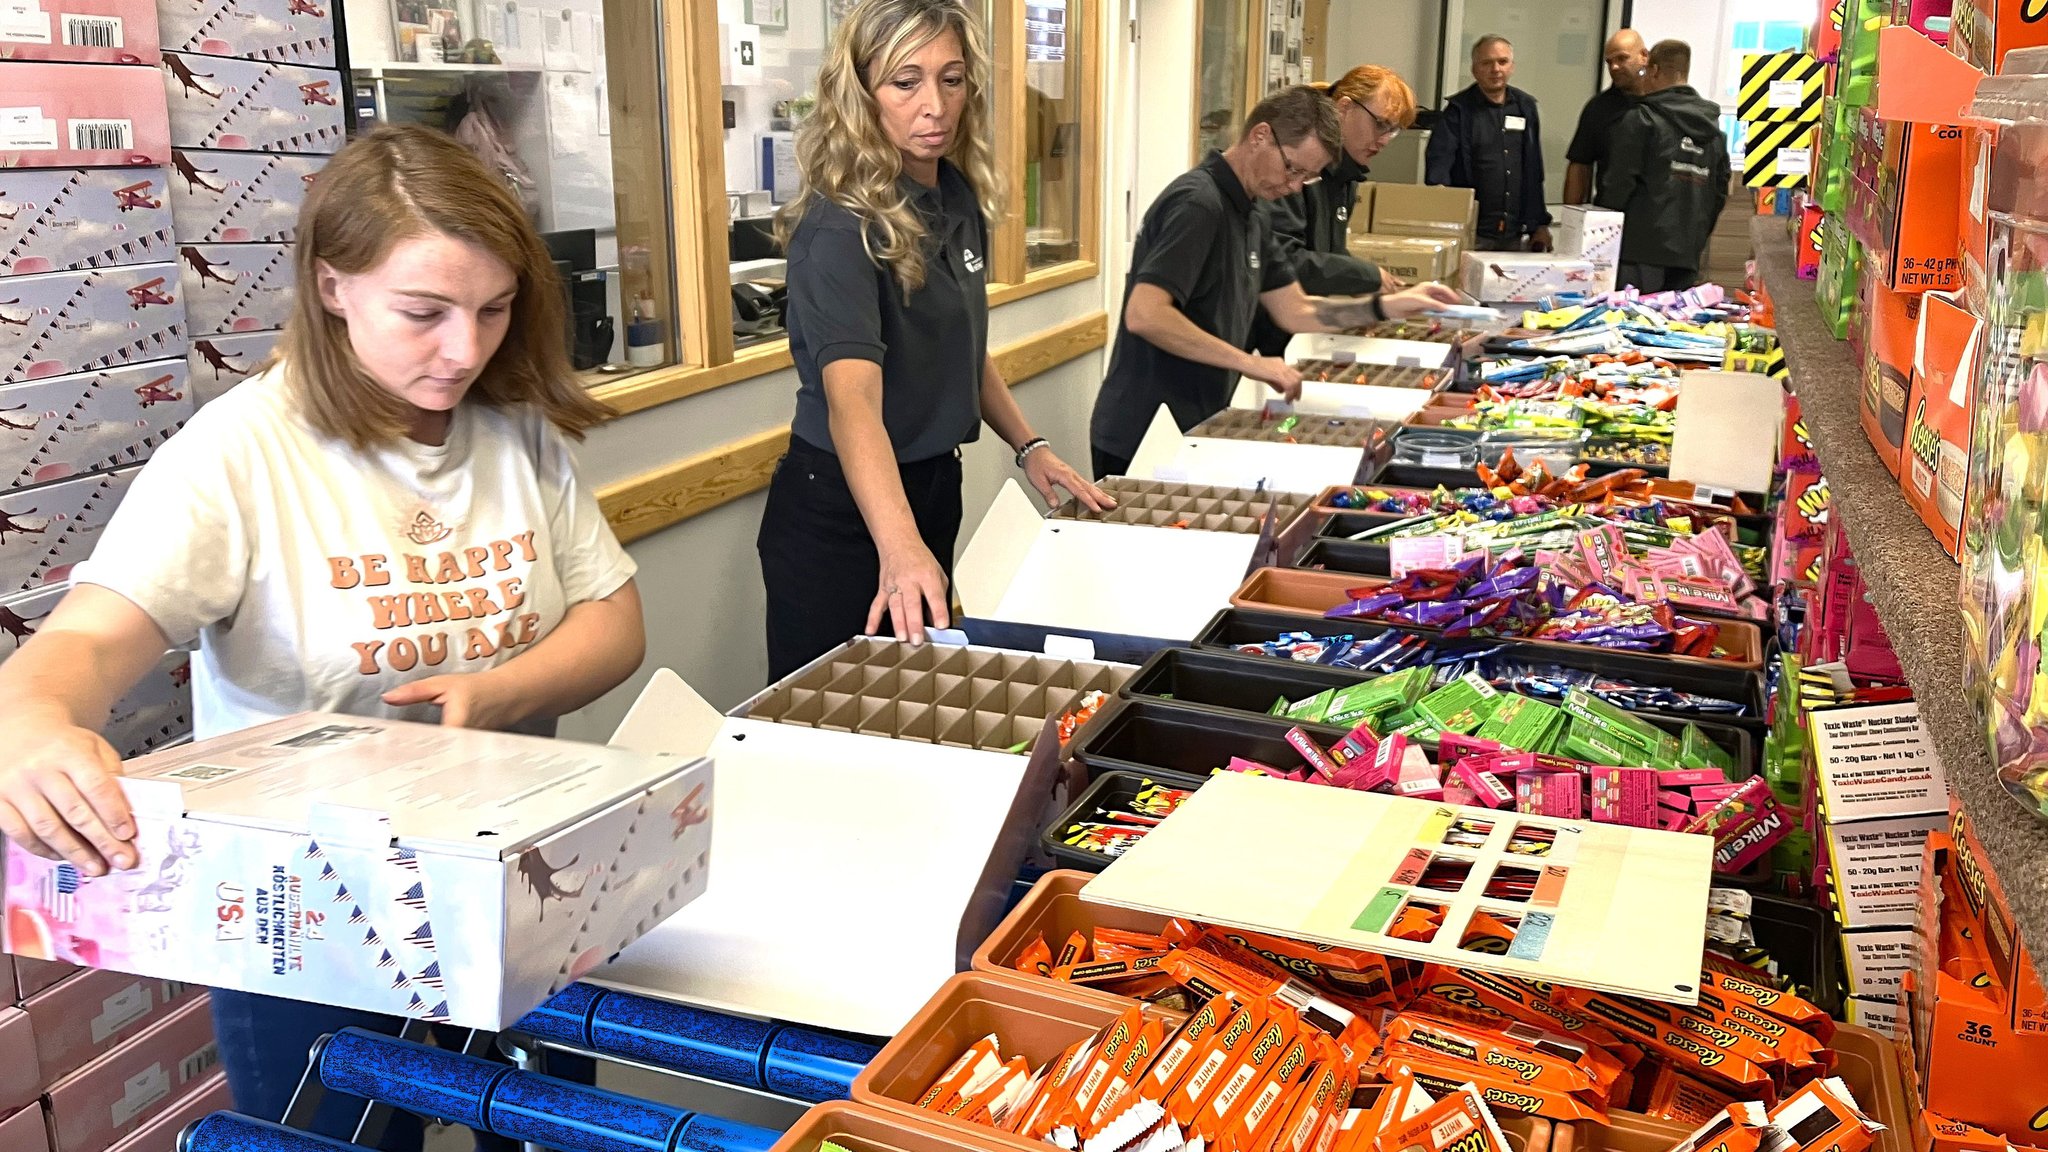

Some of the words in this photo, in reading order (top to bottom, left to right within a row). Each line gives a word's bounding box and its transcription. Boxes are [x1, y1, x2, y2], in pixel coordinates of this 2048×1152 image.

[1902, 273, 1918, 285] NET
[1921, 273, 1935, 284] WT
[1903, 258, 1915, 269] 36
[1924, 258, 1935, 269] 42
[1937, 260, 1944, 272] g
[1910, 396, 1942, 476] Reese's
[327, 554, 391, 589] BE
[402, 530, 538, 584] HAPPY
[367, 577, 526, 629] WHERE
[351, 632, 449, 675] YOU
[1328, 712, 1349, 723] Mike
[1568, 703, 1592, 721] Mike
[1593, 715, 1608, 729] Ike
[1824, 722, 1841, 731] Toxic
[1868, 717, 1893, 726] Nuclear
[1291, 731, 1312, 752] Mike
[1312, 751, 1324, 769] Ike
[1845, 755, 1860, 764] 20g
[1861, 753, 1877, 762] Bars
[1883, 752, 1896, 760] Net
[1904, 751, 1914, 760] kg
[1831, 773, 1932, 787] ToxicWasteCandy.co.uk
[1732, 812, 1782, 853] Mike
[1841, 834, 1858, 843] Toxic
[1885, 831, 1909, 840] Nuclear
[1863, 867, 1877, 876] 20g
[1878, 866, 1895, 874] Bars
[1900, 865, 1914, 873] Net
[1952, 808, 1987, 908] Reese's
[256, 887, 269, 914] AUS
[255, 917, 269, 945] DEN
[1856, 944, 1874, 952] Toxic
[1721, 977, 1780, 1007] Reese's
[1878, 978, 1892, 986] 20g
[1187, 1005, 1216, 1040] Reese's
[1529, 999, 1584, 1032] Reese's
[1864, 1012, 1881, 1020] Toxic
[2022, 1008, 2033, 1018] 36
[2022, 1021, 2037, 1031] NET
[1105, 1020, 1131, 1061] Reese's
[1223, 1009, 1252, 1050] Reese's
[1252, 1023, 1283, 1066] Reese's
[1412, 1032, 1428, 1044] CUPS
[1678, 1016, 1739, 1048] Reese's
[1957, 1033, 1998, 1048] COUNT
[1965, 1020, 1993, 1038] 36
[1122, 1034, 1149, 1077] Reese's
[1161, 1047, 1184, 1074] WHITE
[1278, 1042, 1306, 1083] Reese's
[1663, 1032, 1725, 1067] Reese's
[1193, 1058, 1218, 1090] WHITE
[1486, 1050, 1544, 1081] Reese's
[1082, 1068, 1103, 1099] WHITE
[1222, 1073, 1247, 1105] WHITE
[1316, 1069, 1337, 1109] Reese's
[1096, 1086, 1119, 1117] WHITE
[1252, 1090, 1274, 1121] WHITE
[1483, 1088, 1544, 1113] Reese's
[1298, 1114, 1314, 1145] WHITE
[1438, 1119, 1464, 1140] WHITE
